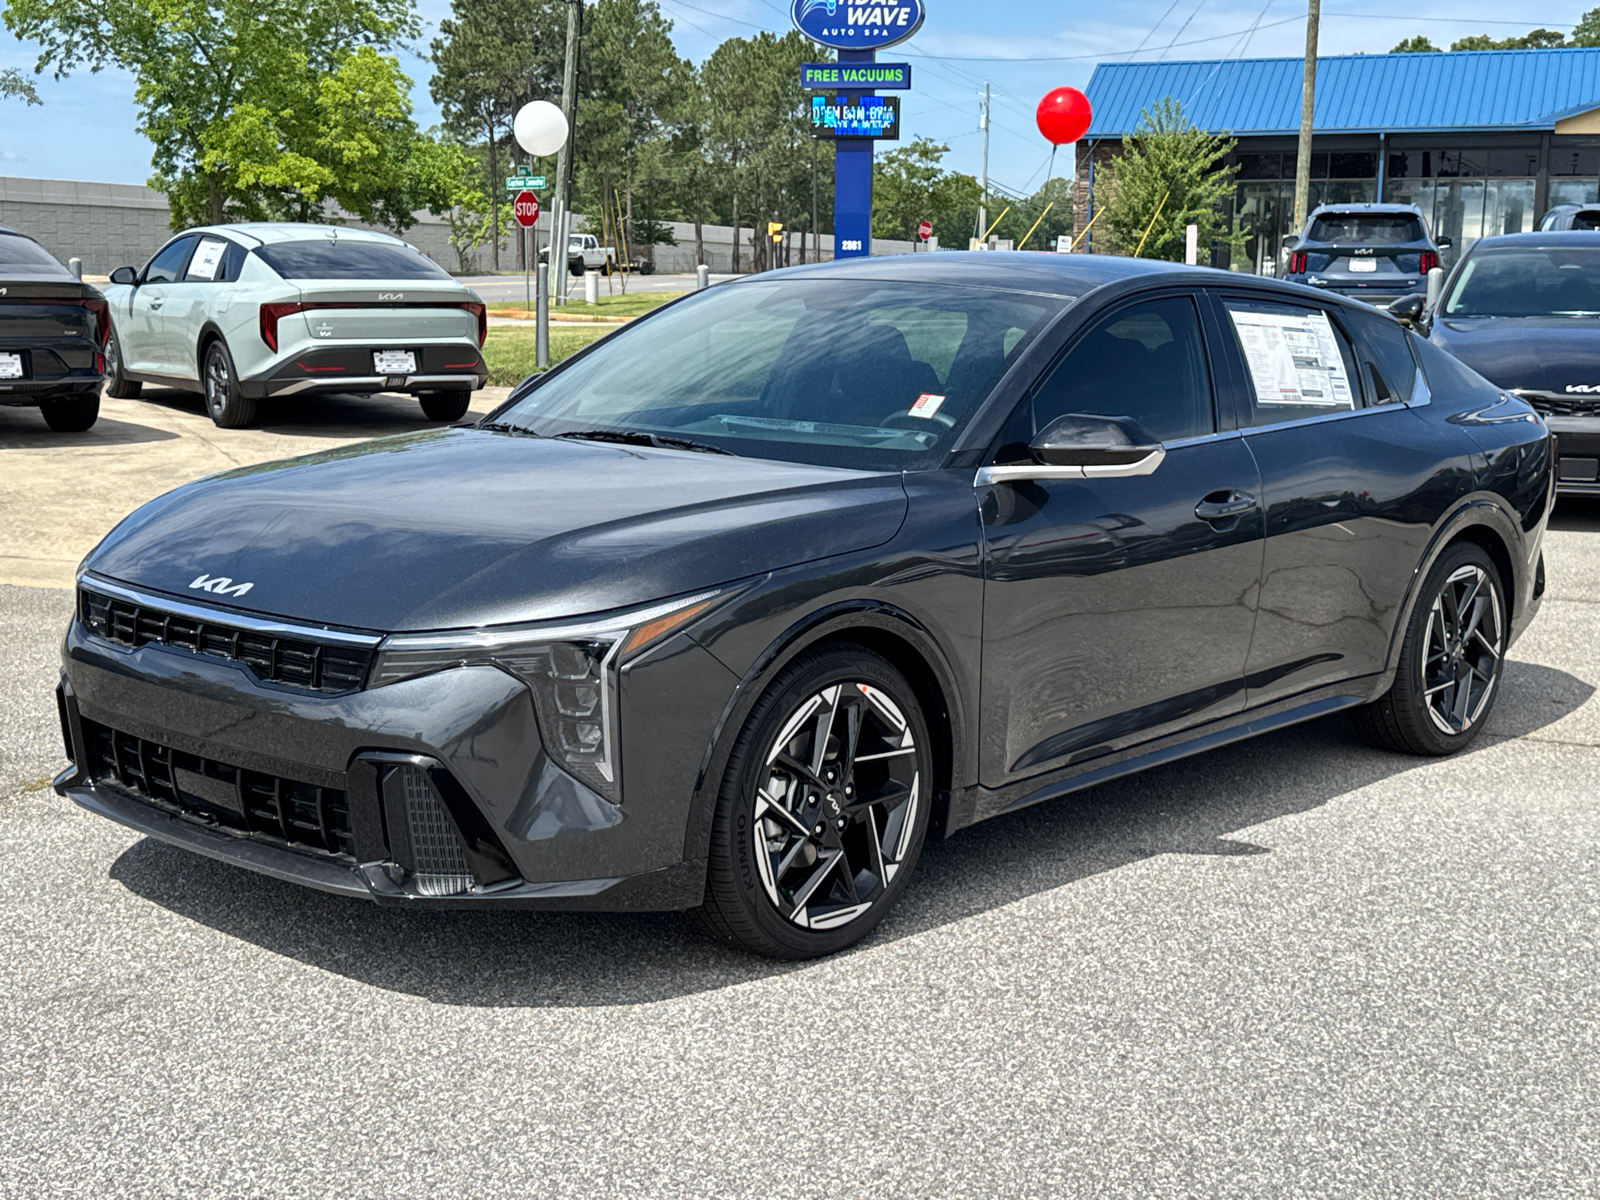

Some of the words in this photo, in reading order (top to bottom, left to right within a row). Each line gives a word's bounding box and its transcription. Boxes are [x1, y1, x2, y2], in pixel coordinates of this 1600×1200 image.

[847, 7, 911, 26] WAVE
[822, 28, 855, 36] AUTO
[864, 28, 889, 37] SPA
[806, 69, 839, 82] FREE
[842, 68, 903, 82] VACUUMS
[516, 202, 538, 216] STOP
[378, 292, 404, 301] KIA
[188, 573, 255, 598] KIA
[826, 793, 841, 815] KIA
[736, 813, 754, 891] KUMHO
